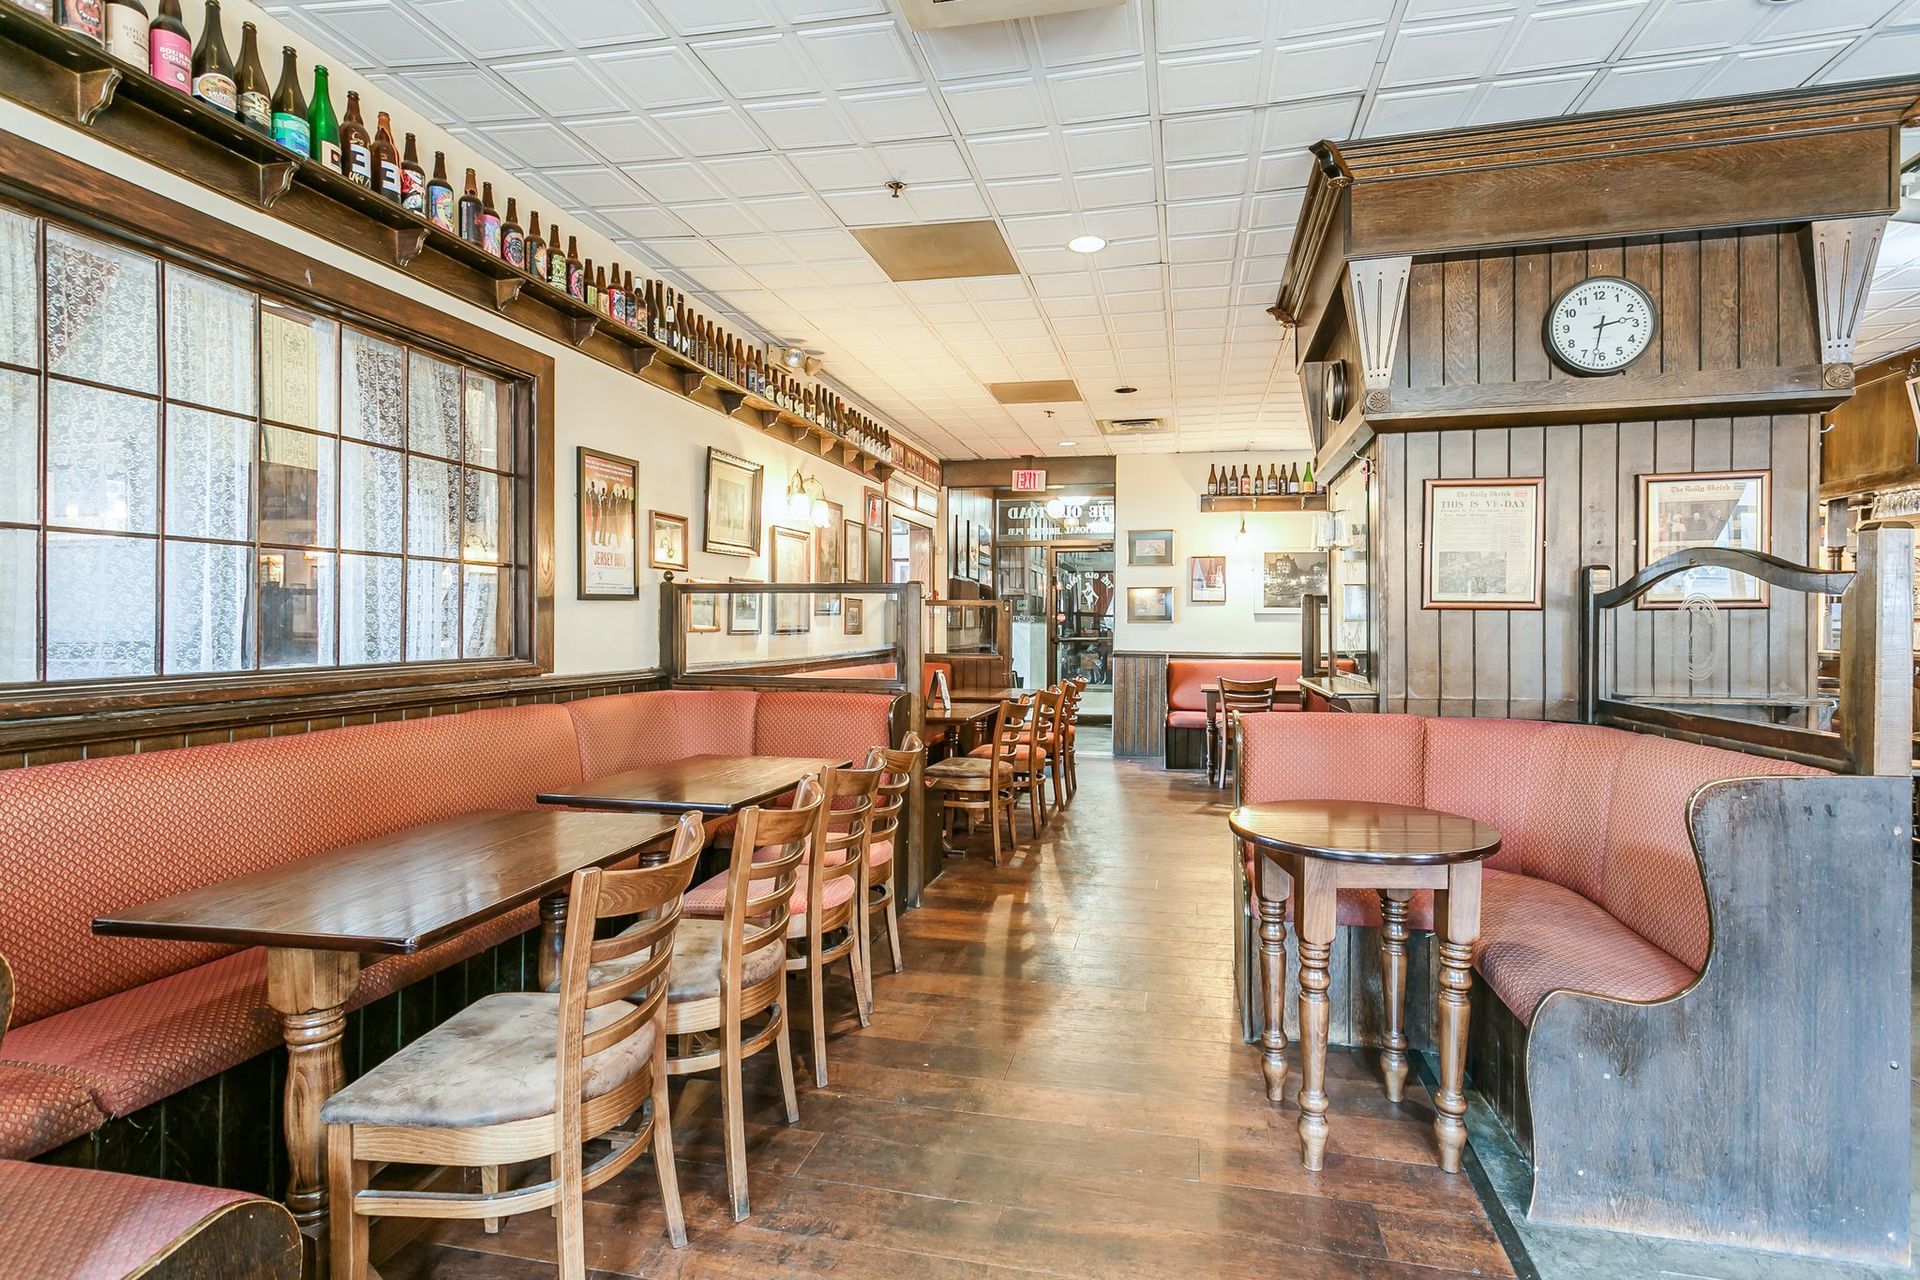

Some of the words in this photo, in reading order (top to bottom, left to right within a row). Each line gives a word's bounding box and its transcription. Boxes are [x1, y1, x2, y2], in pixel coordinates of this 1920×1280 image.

[1593, 291, 1606, 300] 12
[1614, 294, 1620, 302] 1
[1578, 297, 1588, 306] 11
[1627, 304, 1634, 312] 2
[1564, 309, 1576, 318] 10
[1632, 318, 1640, 328] 3
[1562, 324, 1570, 334] 9
[1628, 334, 1636, 343] 4
[1568, 340, 1576, 348] 8
[1581, 350, 1588, 358] 7
[1616, 346, 1624, 356] 5
[1598, 352, 1606, 361] 6
[1016, 471, 1040, 489] EXIT
[1440, 500, 1464, 508] THIS
[1470, 500, 1479, 508] IS
[1486, 500, 1526, 508] VE-DAY
